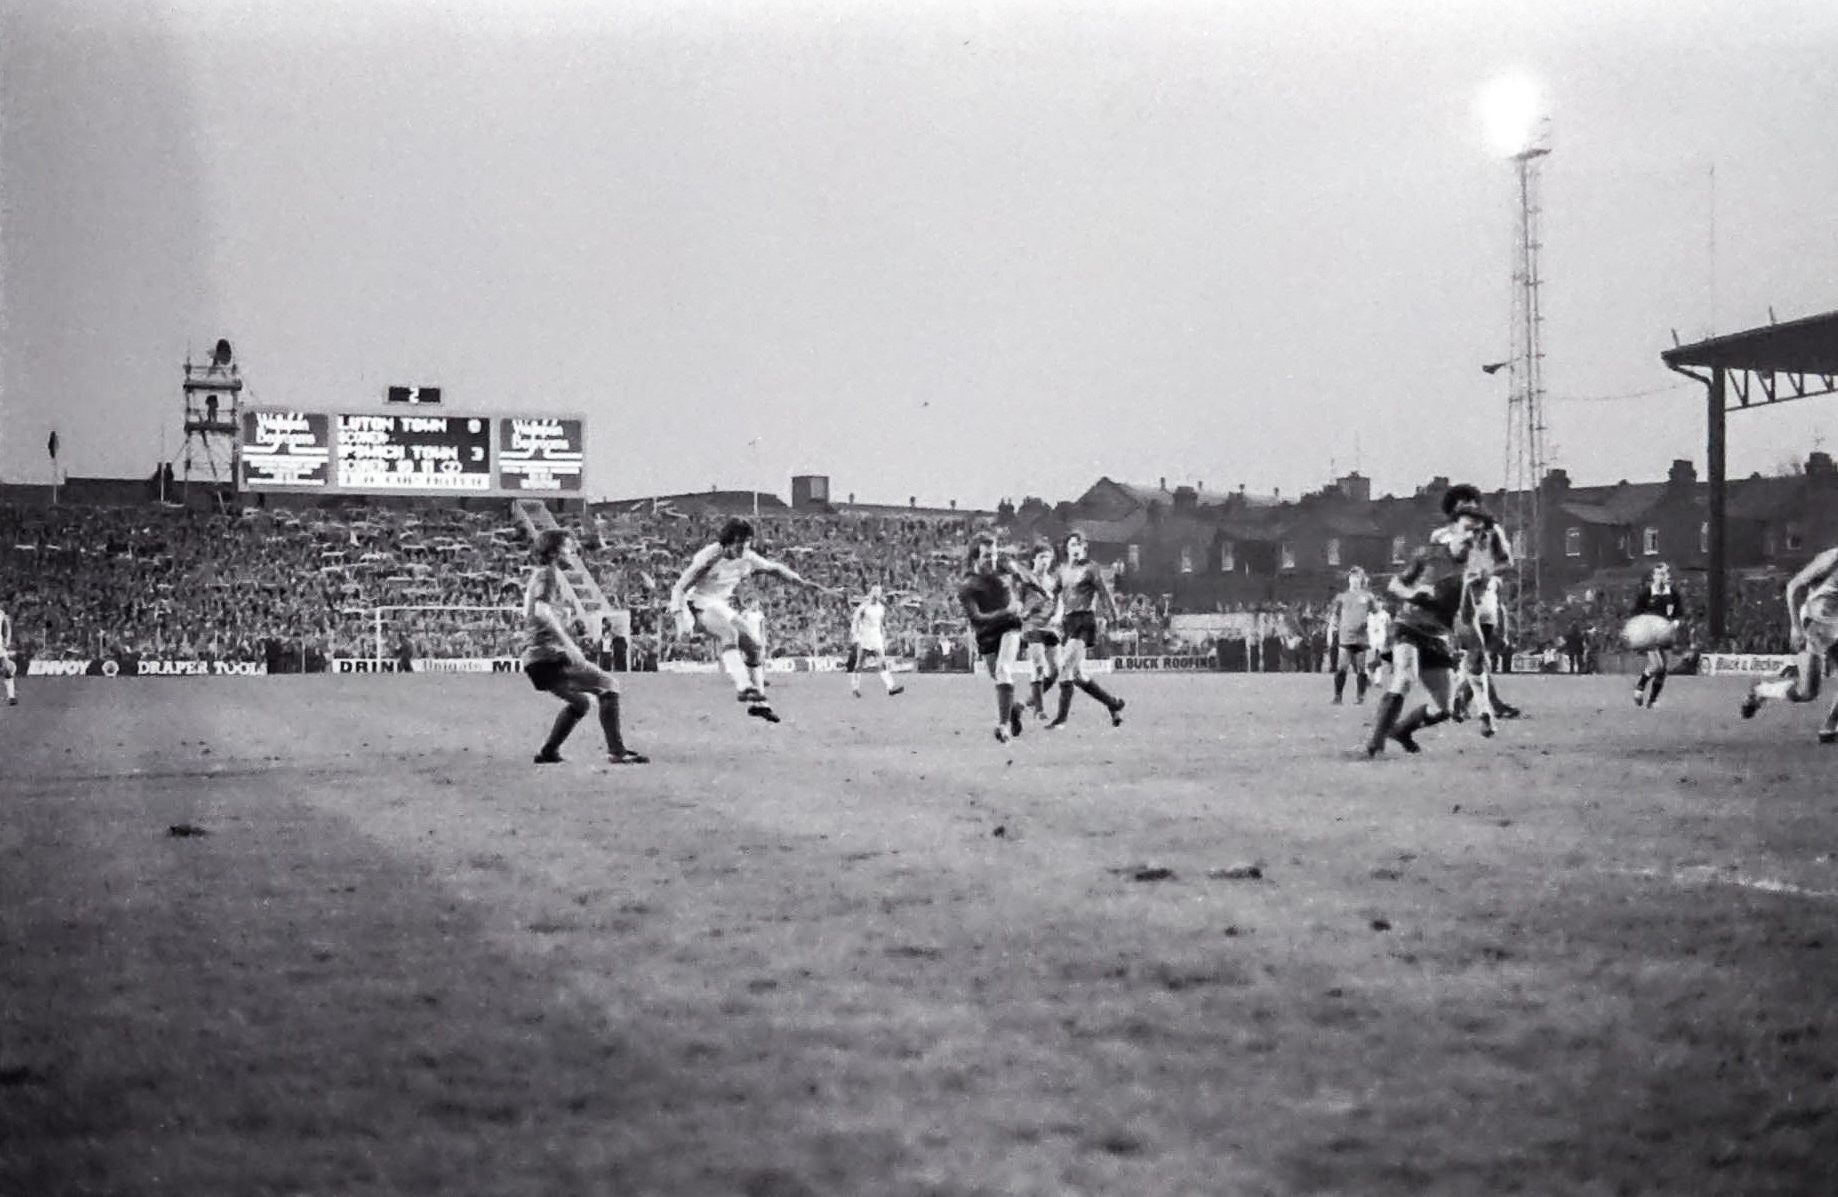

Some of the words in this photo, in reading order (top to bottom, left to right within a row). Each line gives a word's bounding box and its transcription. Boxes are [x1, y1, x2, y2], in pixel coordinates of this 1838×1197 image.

[409, 386, 419, 404] 2
[337, 415, 395, 432] LUTON
[401, 417, 448, 433] TOWN
[337, 444, 405, 460] IPSWICH
[411, 445, 459, 460] TOWN
[470, 446, 485, 462] 3
[27, 660, 92, 676] ENVOY
[137, 660, 209, 675] DRAPER
[1163, 656, 1217, 670] ROOFING
